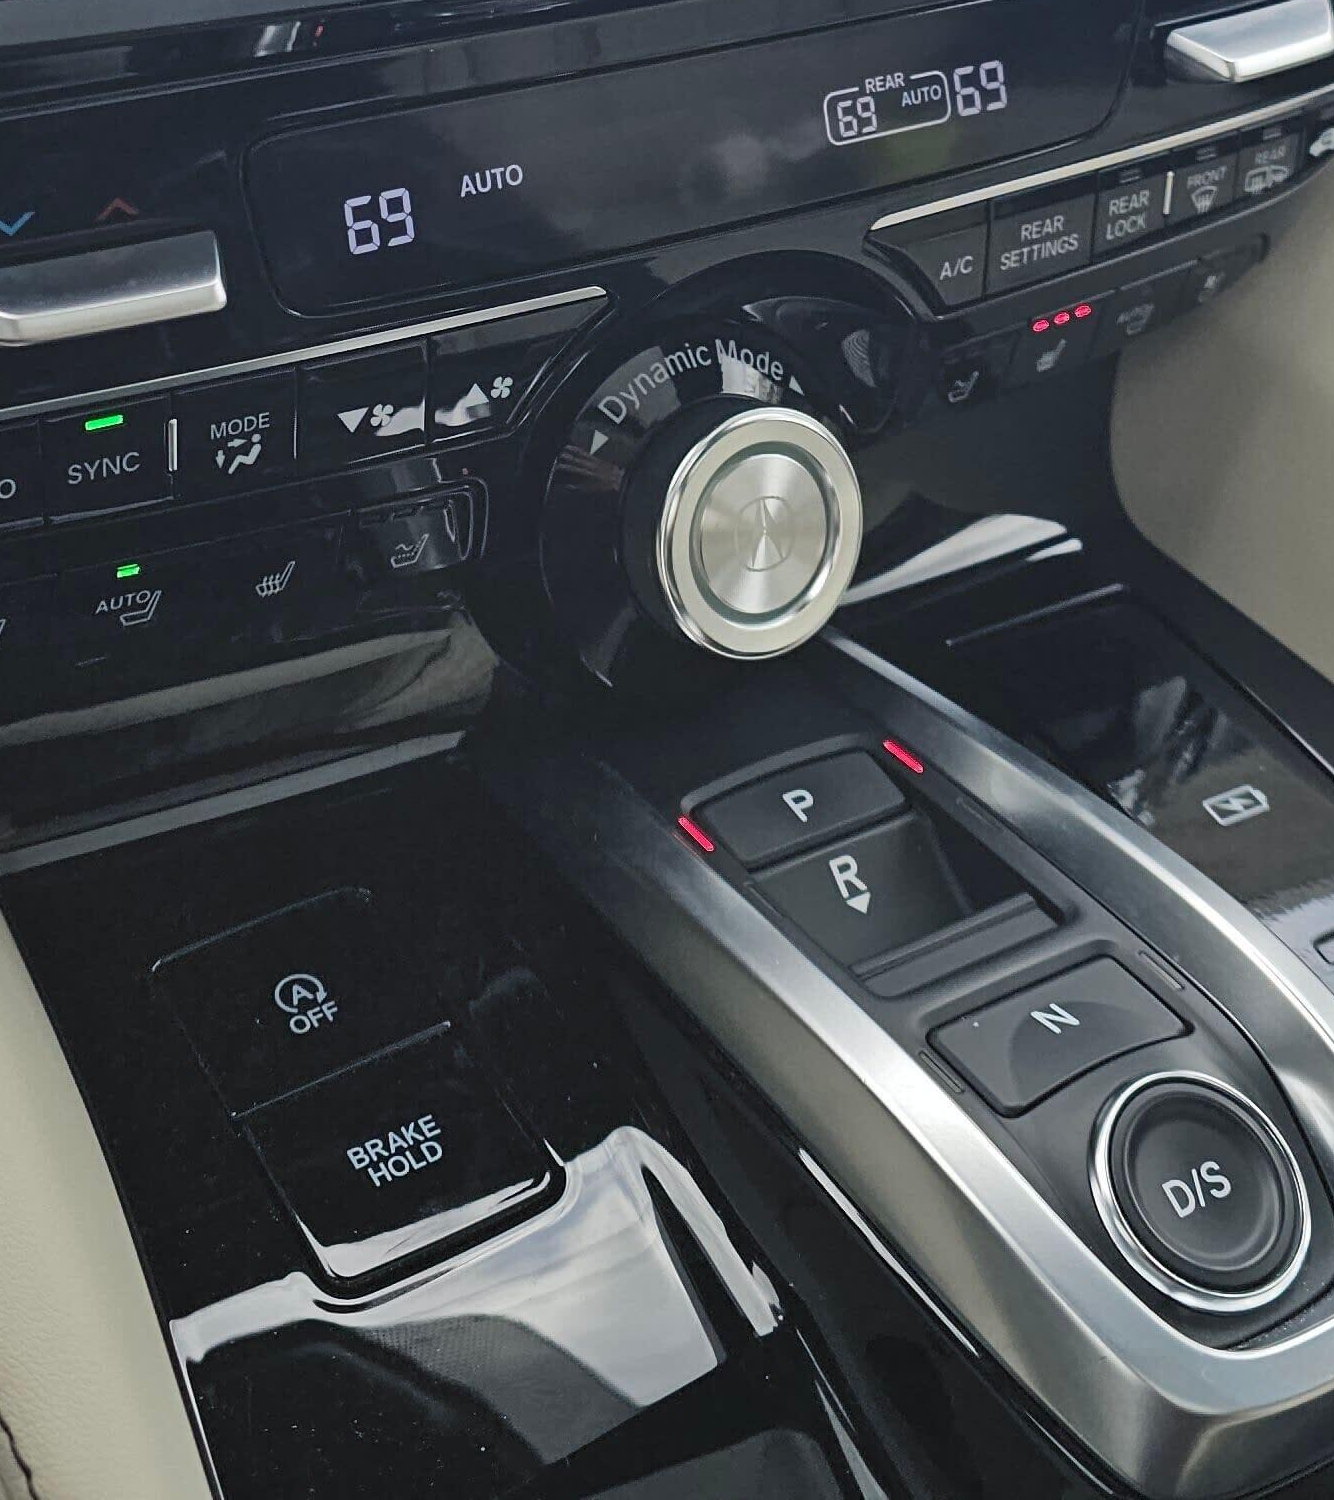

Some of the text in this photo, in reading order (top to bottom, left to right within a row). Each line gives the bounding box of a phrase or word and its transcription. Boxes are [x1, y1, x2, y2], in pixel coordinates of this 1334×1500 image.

[836, 60, 1008, 138] 69 AUTO 69
[865, 72, 906, 93] REAR
[1186, 165, 1228, 190] FRONT
[343, 164, 524, 256] 69 AUTO
[1108, 190, 1150, 217] REAR
[1020, 215, 1065, 242] REAR
[1106, 214, 1146, 240] LOCK
[939, 255, 974, 281] A/C
[999, 233, 1079, 272] SETTINGS
[597, 338, 784, 425] Dynamic Mode
[210, 411, 271, 441] MODE
[67, 451, 141, 486] SYNC
[94, 589, 151, 615] AUTO
[782, 788, 816, 823] P
[828, 854, 867, 898] R
[289, 1000, 339, 1035] OFF
[1030, 1002, 1080, 1034] N
[346, 1114, 442, 1170] BRAKE
[367, 1140, 443, 1187] HOLD
[1161, 1159, 1232, 1219] D/S
